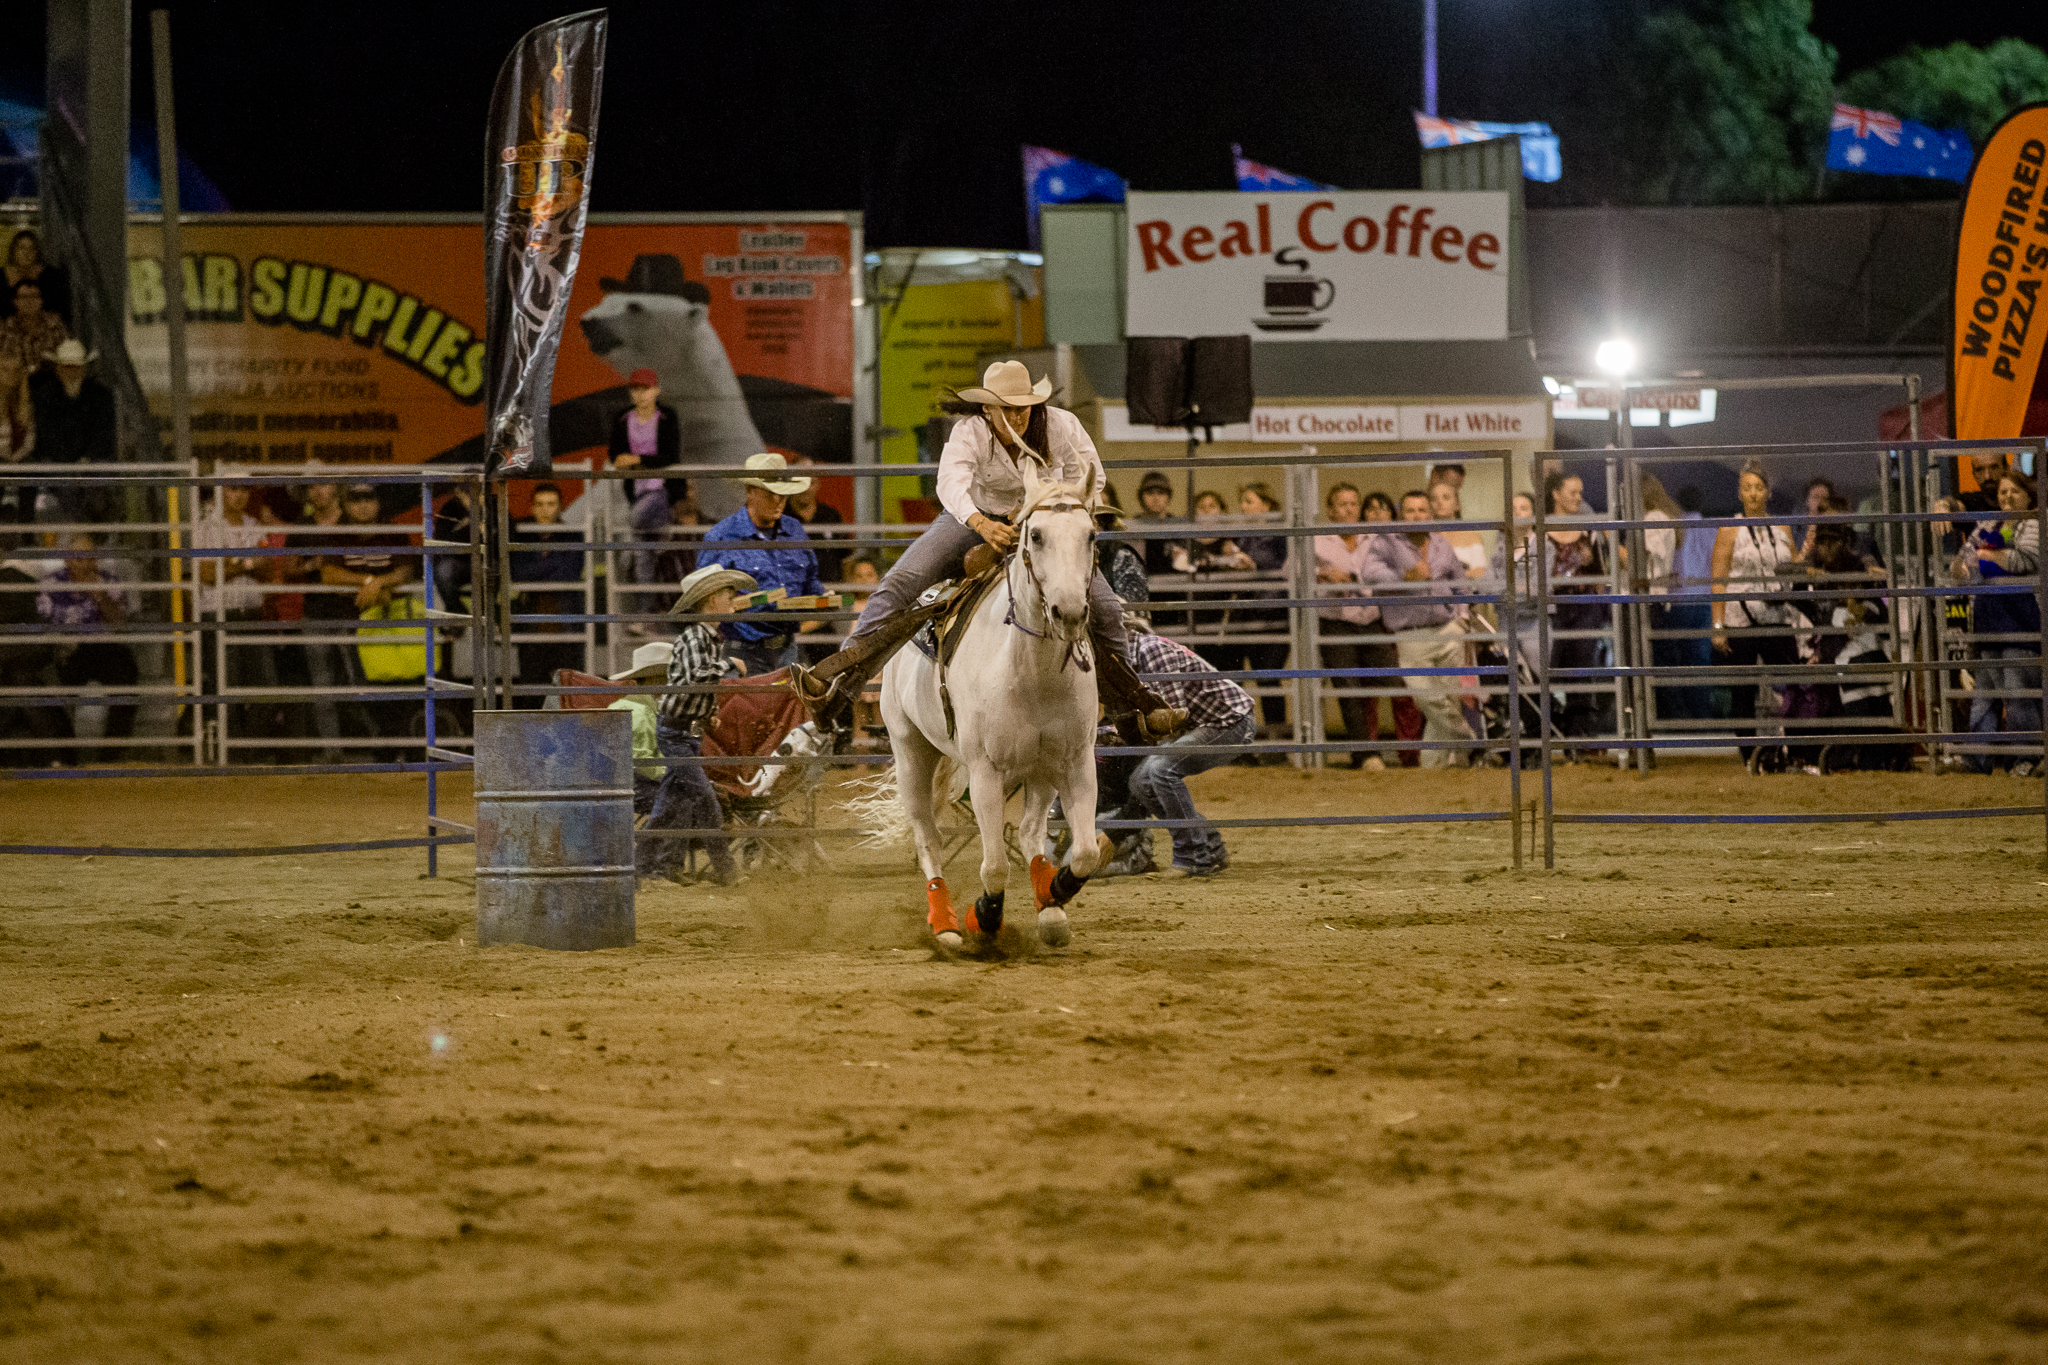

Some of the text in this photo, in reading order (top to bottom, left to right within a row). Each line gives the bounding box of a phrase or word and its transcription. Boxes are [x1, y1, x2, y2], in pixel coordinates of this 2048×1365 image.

[501, 158, 586, 198] UP
[1136, 200, 1500, 272] Real Coffee
[1961, 138, 2047, 358] WOODFIRED
[251, 254, 486, 405] SUPPLIES
[1991, 242, 2048, 382] PIZZA'S
[1256, 413, 1394, 434] Hot Chocolate
[1425, 411, 1522, 433] Flat White
[1579, 388, 1699, 412] Cauccino
